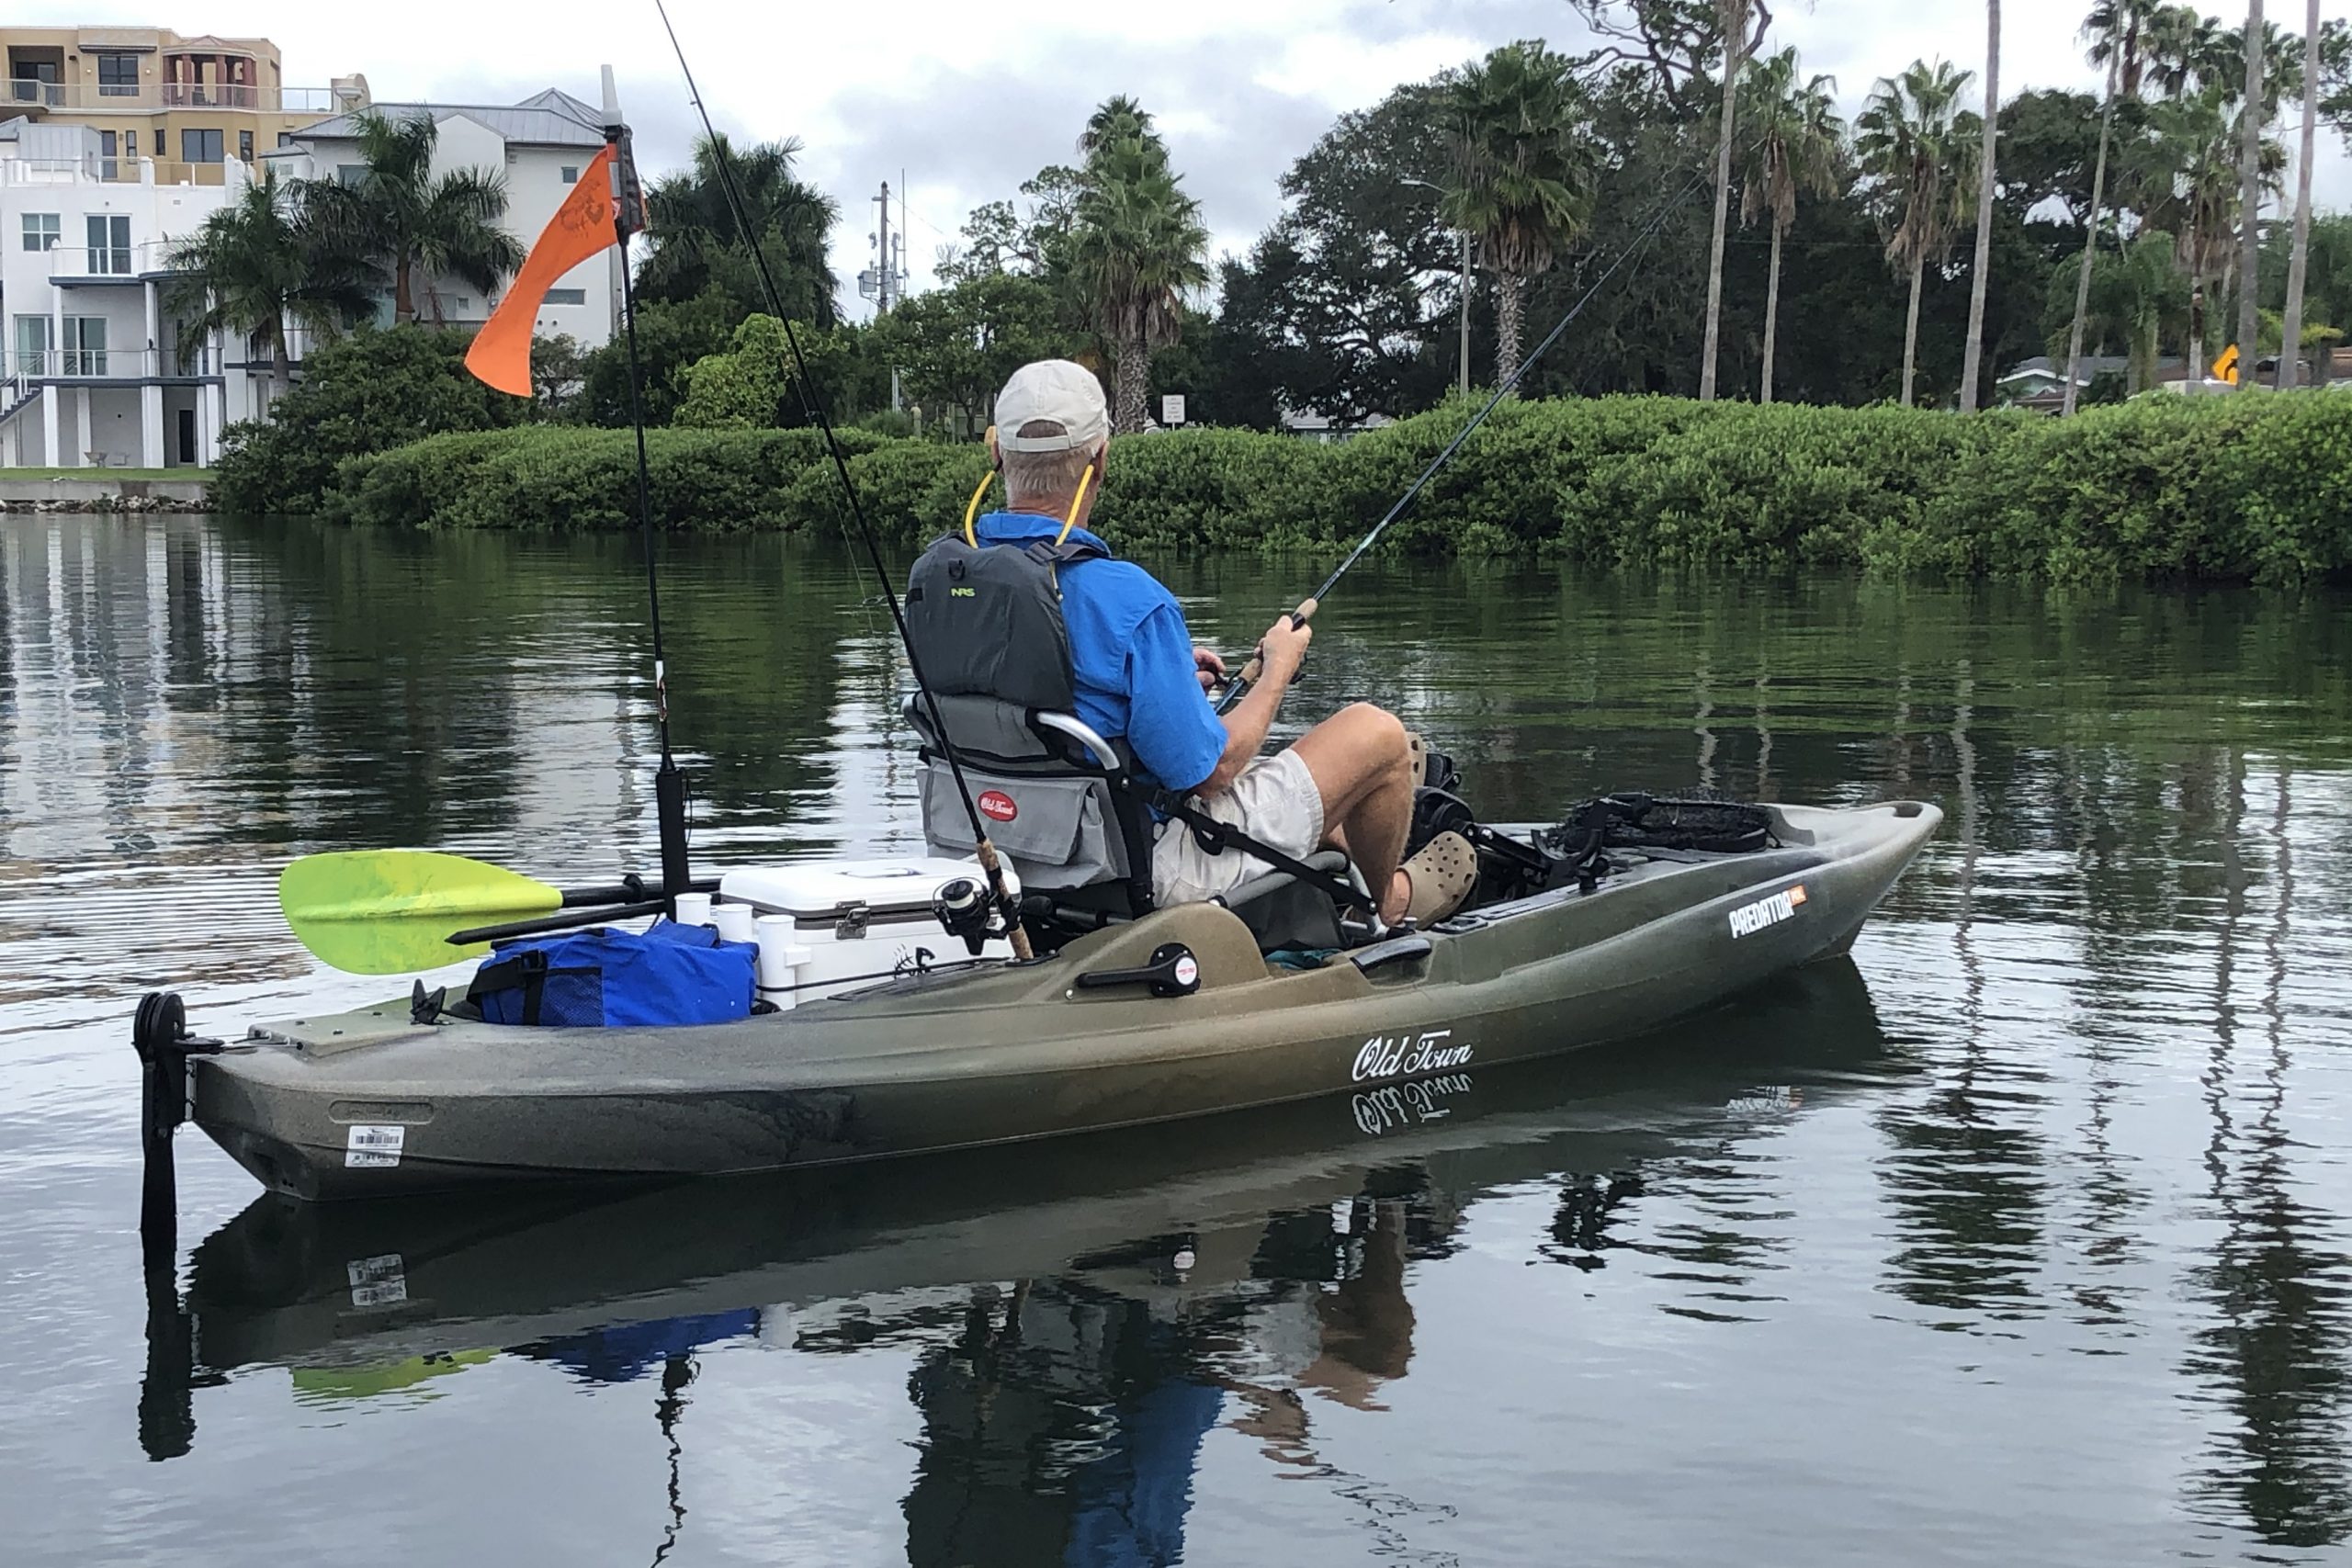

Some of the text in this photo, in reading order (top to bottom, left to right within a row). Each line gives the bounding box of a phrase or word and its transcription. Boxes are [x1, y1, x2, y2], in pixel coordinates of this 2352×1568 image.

[951, 588, 976, 597] NRS
[1728, 889, 1795, 939] PREDATOR
[1351, 1029, 1475, 1082] Old Town
